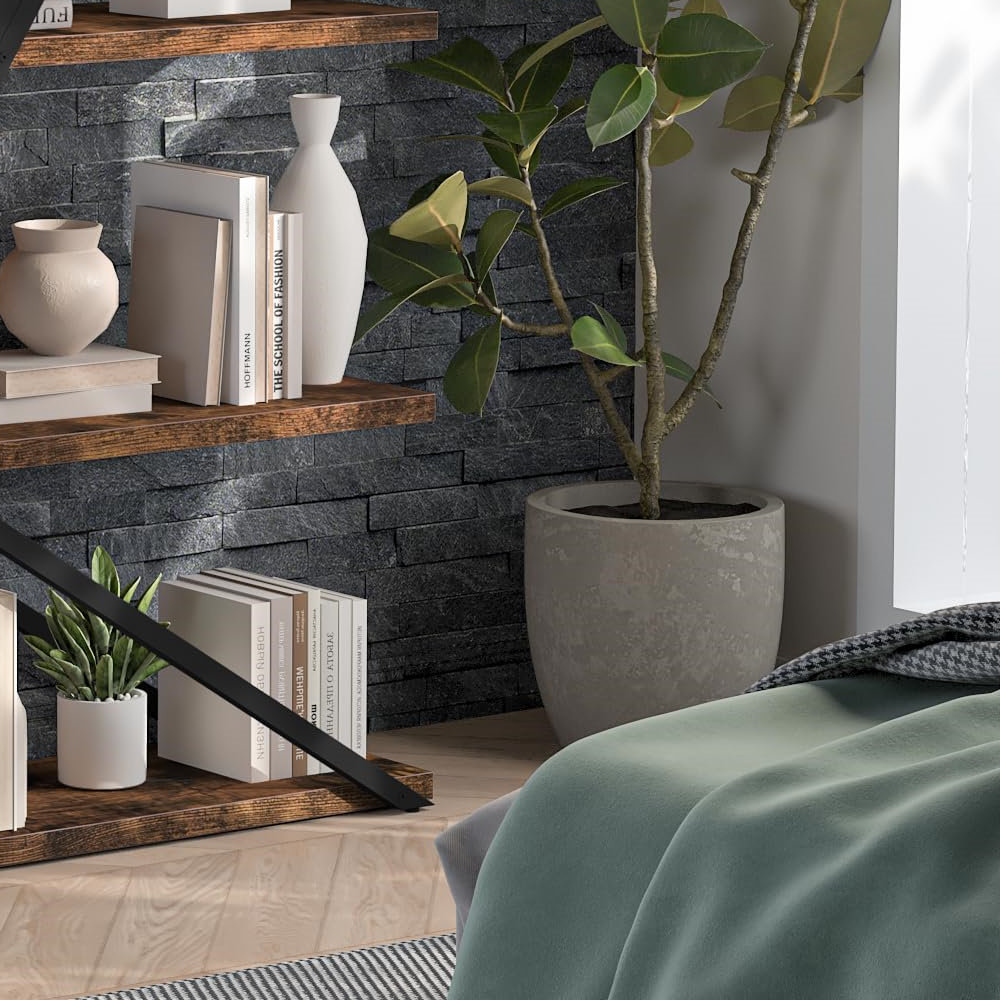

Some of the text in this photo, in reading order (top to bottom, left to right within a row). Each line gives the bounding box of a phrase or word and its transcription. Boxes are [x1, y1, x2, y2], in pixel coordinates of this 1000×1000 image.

[273, 249, 284, 392] THE SCHOOL OF FASHION
